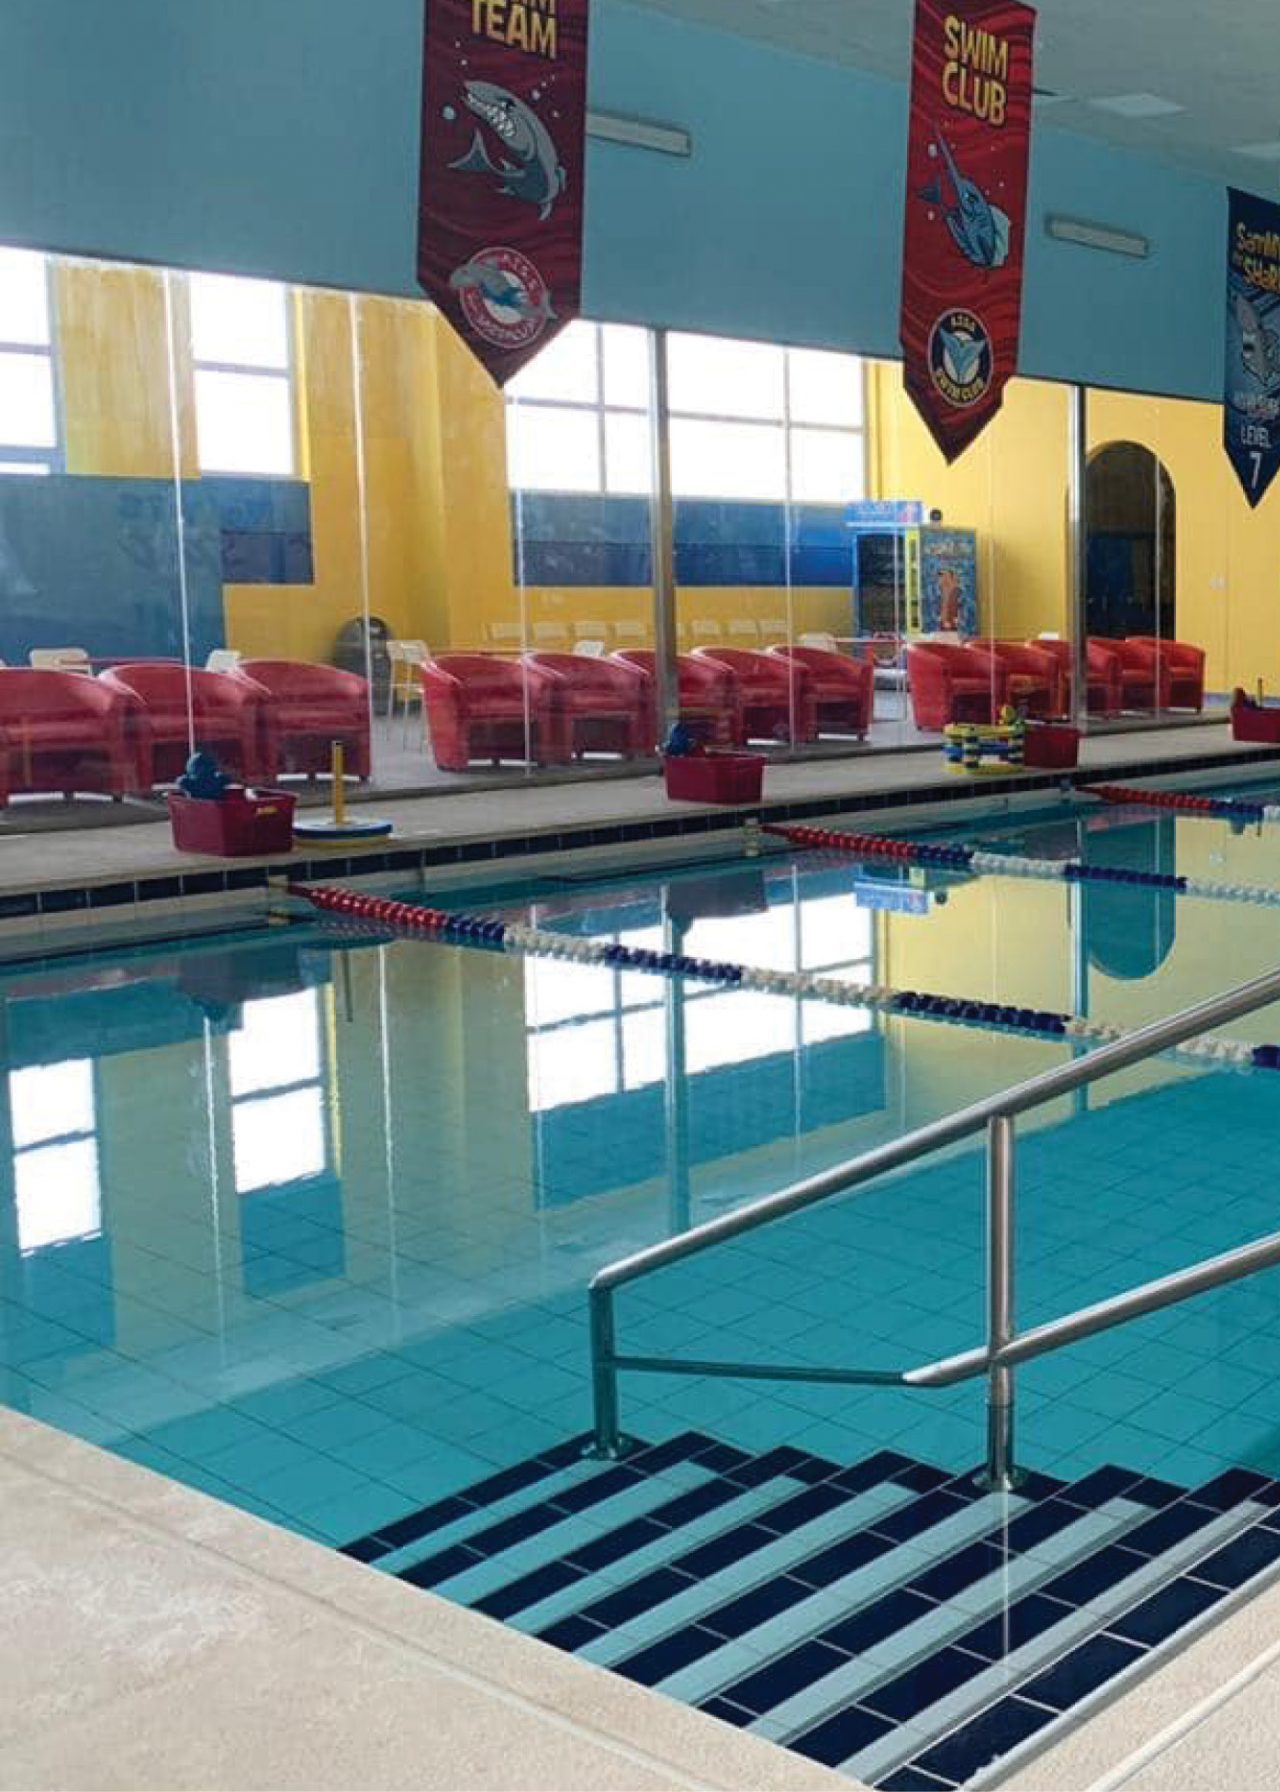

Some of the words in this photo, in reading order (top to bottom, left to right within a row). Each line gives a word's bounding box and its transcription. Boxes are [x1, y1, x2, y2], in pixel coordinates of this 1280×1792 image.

[472, 0, 556, 59] TEAM
[944, 15, 1008, 80] SWIM
[942, 61, 1006, 126] CLUB
[1249, 451, 1262, 489] 7
